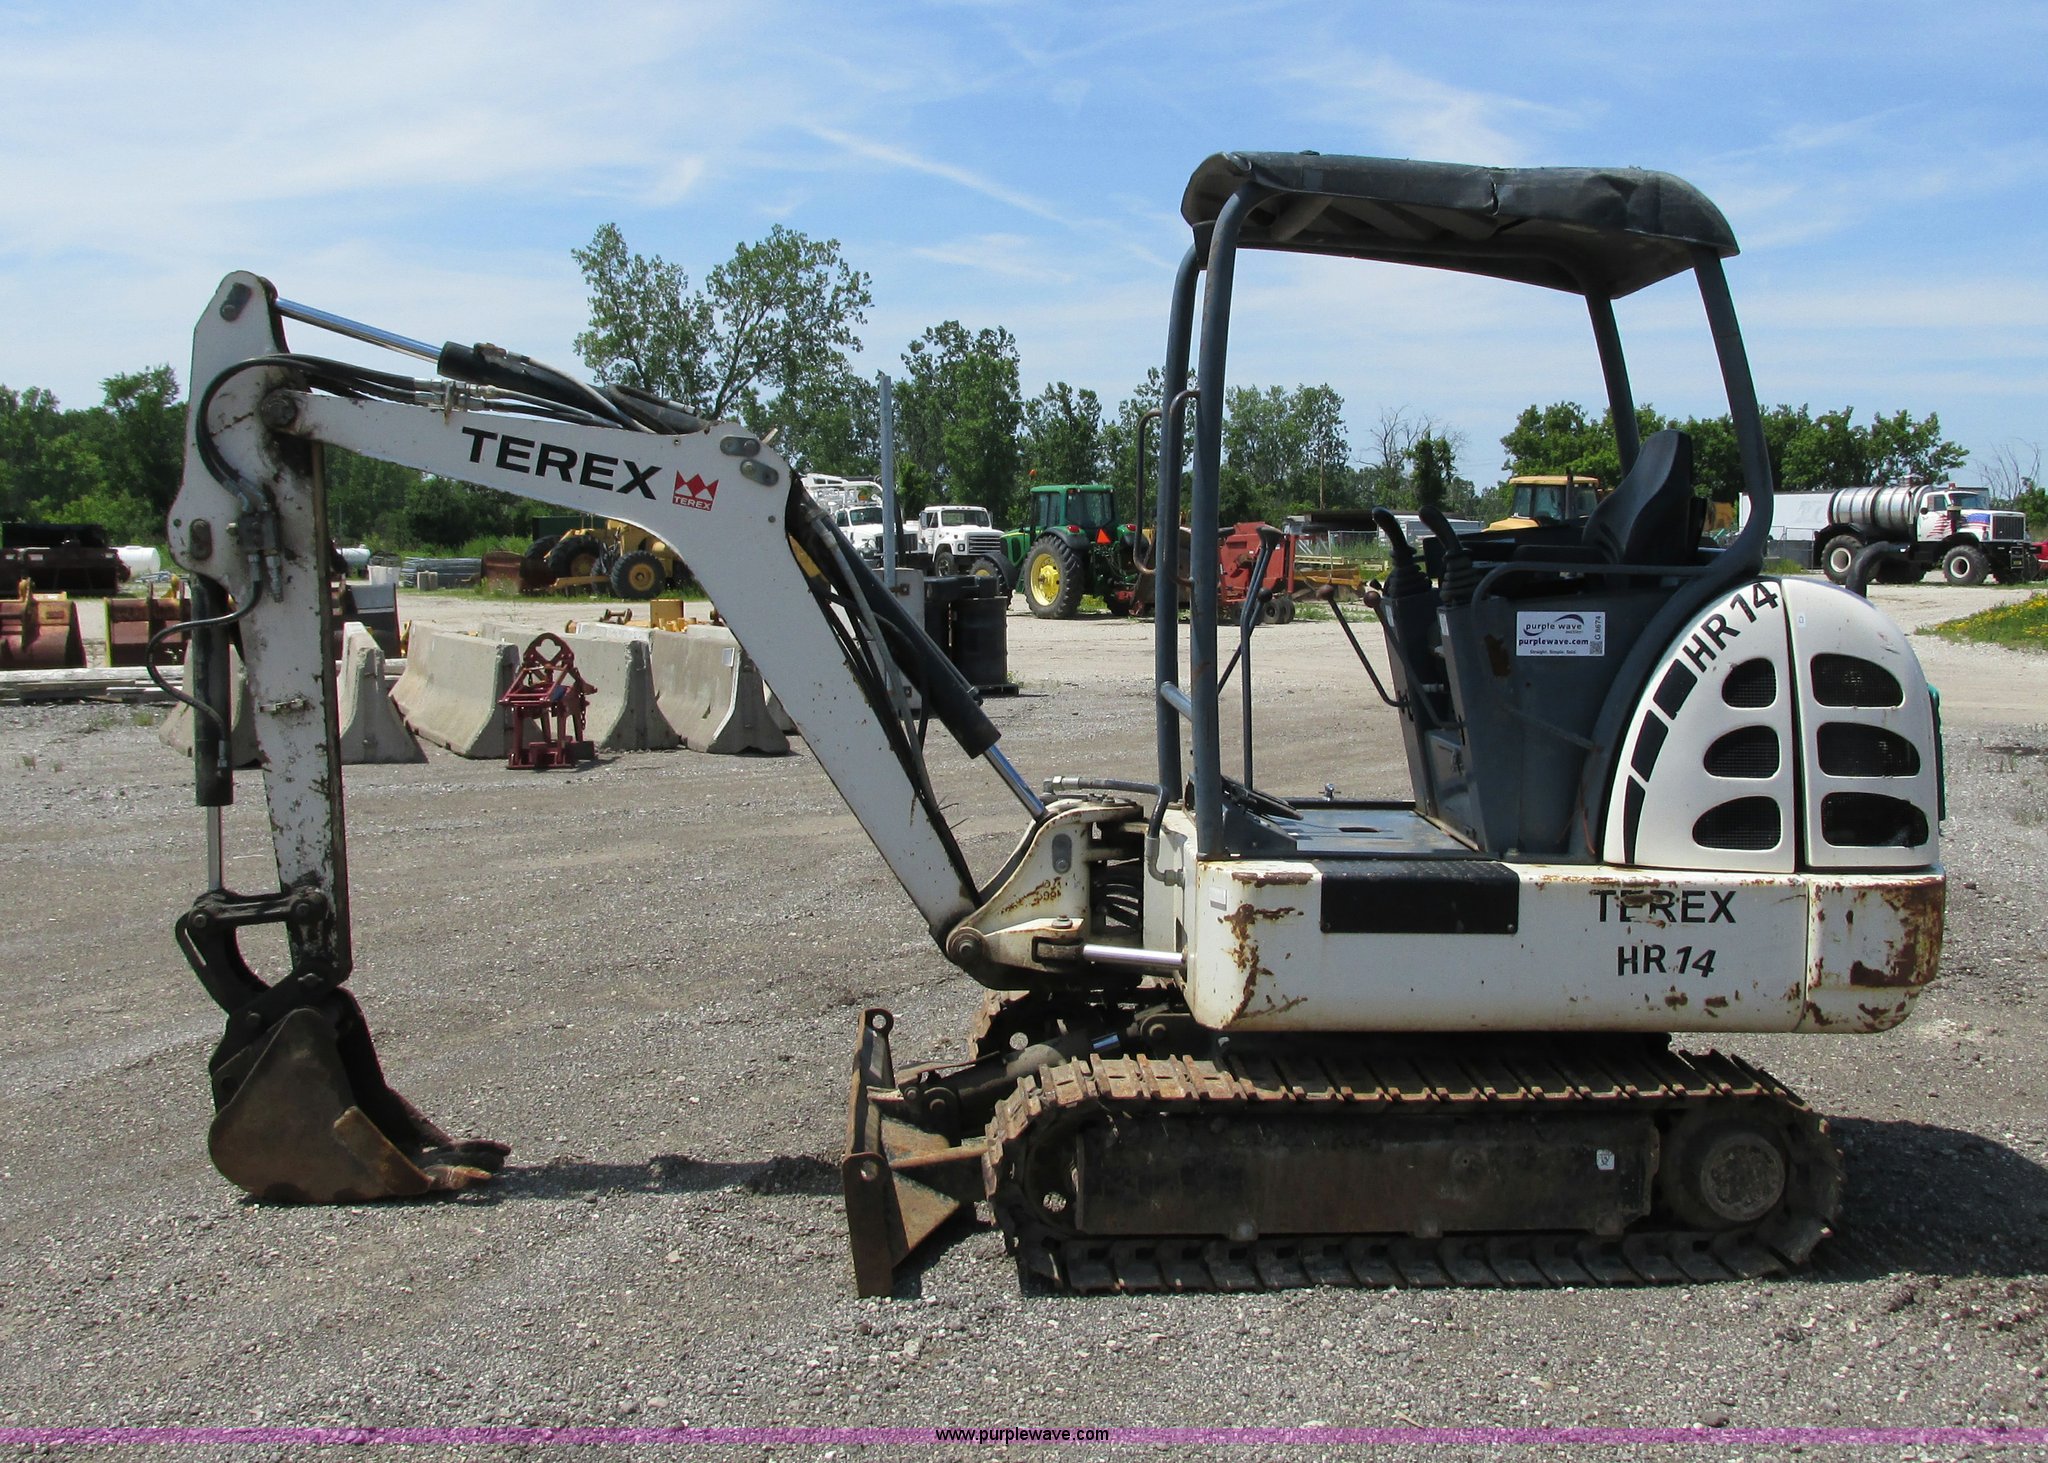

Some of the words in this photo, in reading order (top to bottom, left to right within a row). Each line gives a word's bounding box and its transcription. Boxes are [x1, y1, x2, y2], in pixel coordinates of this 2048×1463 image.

[462, 426, 663, 500] TEREX
[674, 496, 713, 511] TEREX
[1525, 622, 1555, 632] purple
[1518, 637, 1589, 646] purplewave.com
[1594, 889, 1737, 924] TEREX
